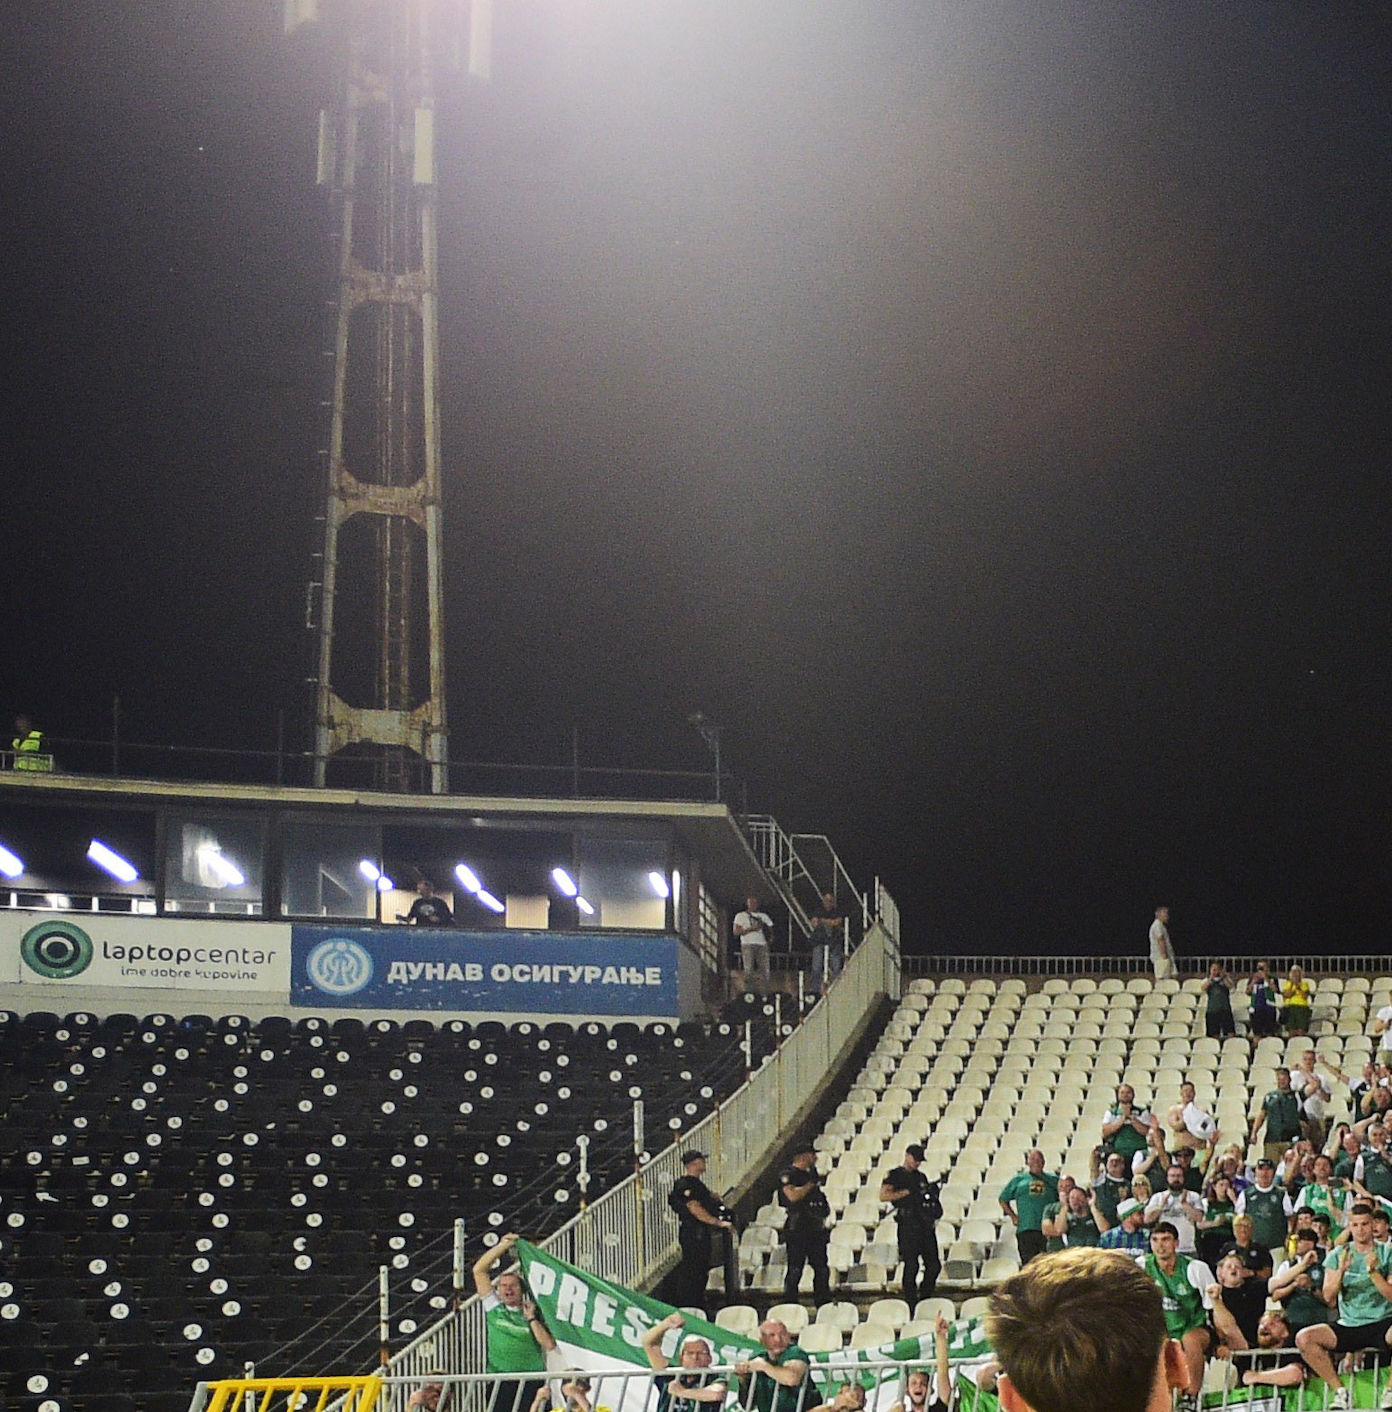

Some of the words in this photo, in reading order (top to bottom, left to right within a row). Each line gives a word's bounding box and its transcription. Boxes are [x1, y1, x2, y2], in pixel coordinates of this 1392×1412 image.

[103, 941, 276, 965] laptopcentar
[150, 967, 191, 978] dobre
[387, 961, 482, 984] ДУНАВ
[490, 963, 661, 986] ОСИГУРАЊЕ
